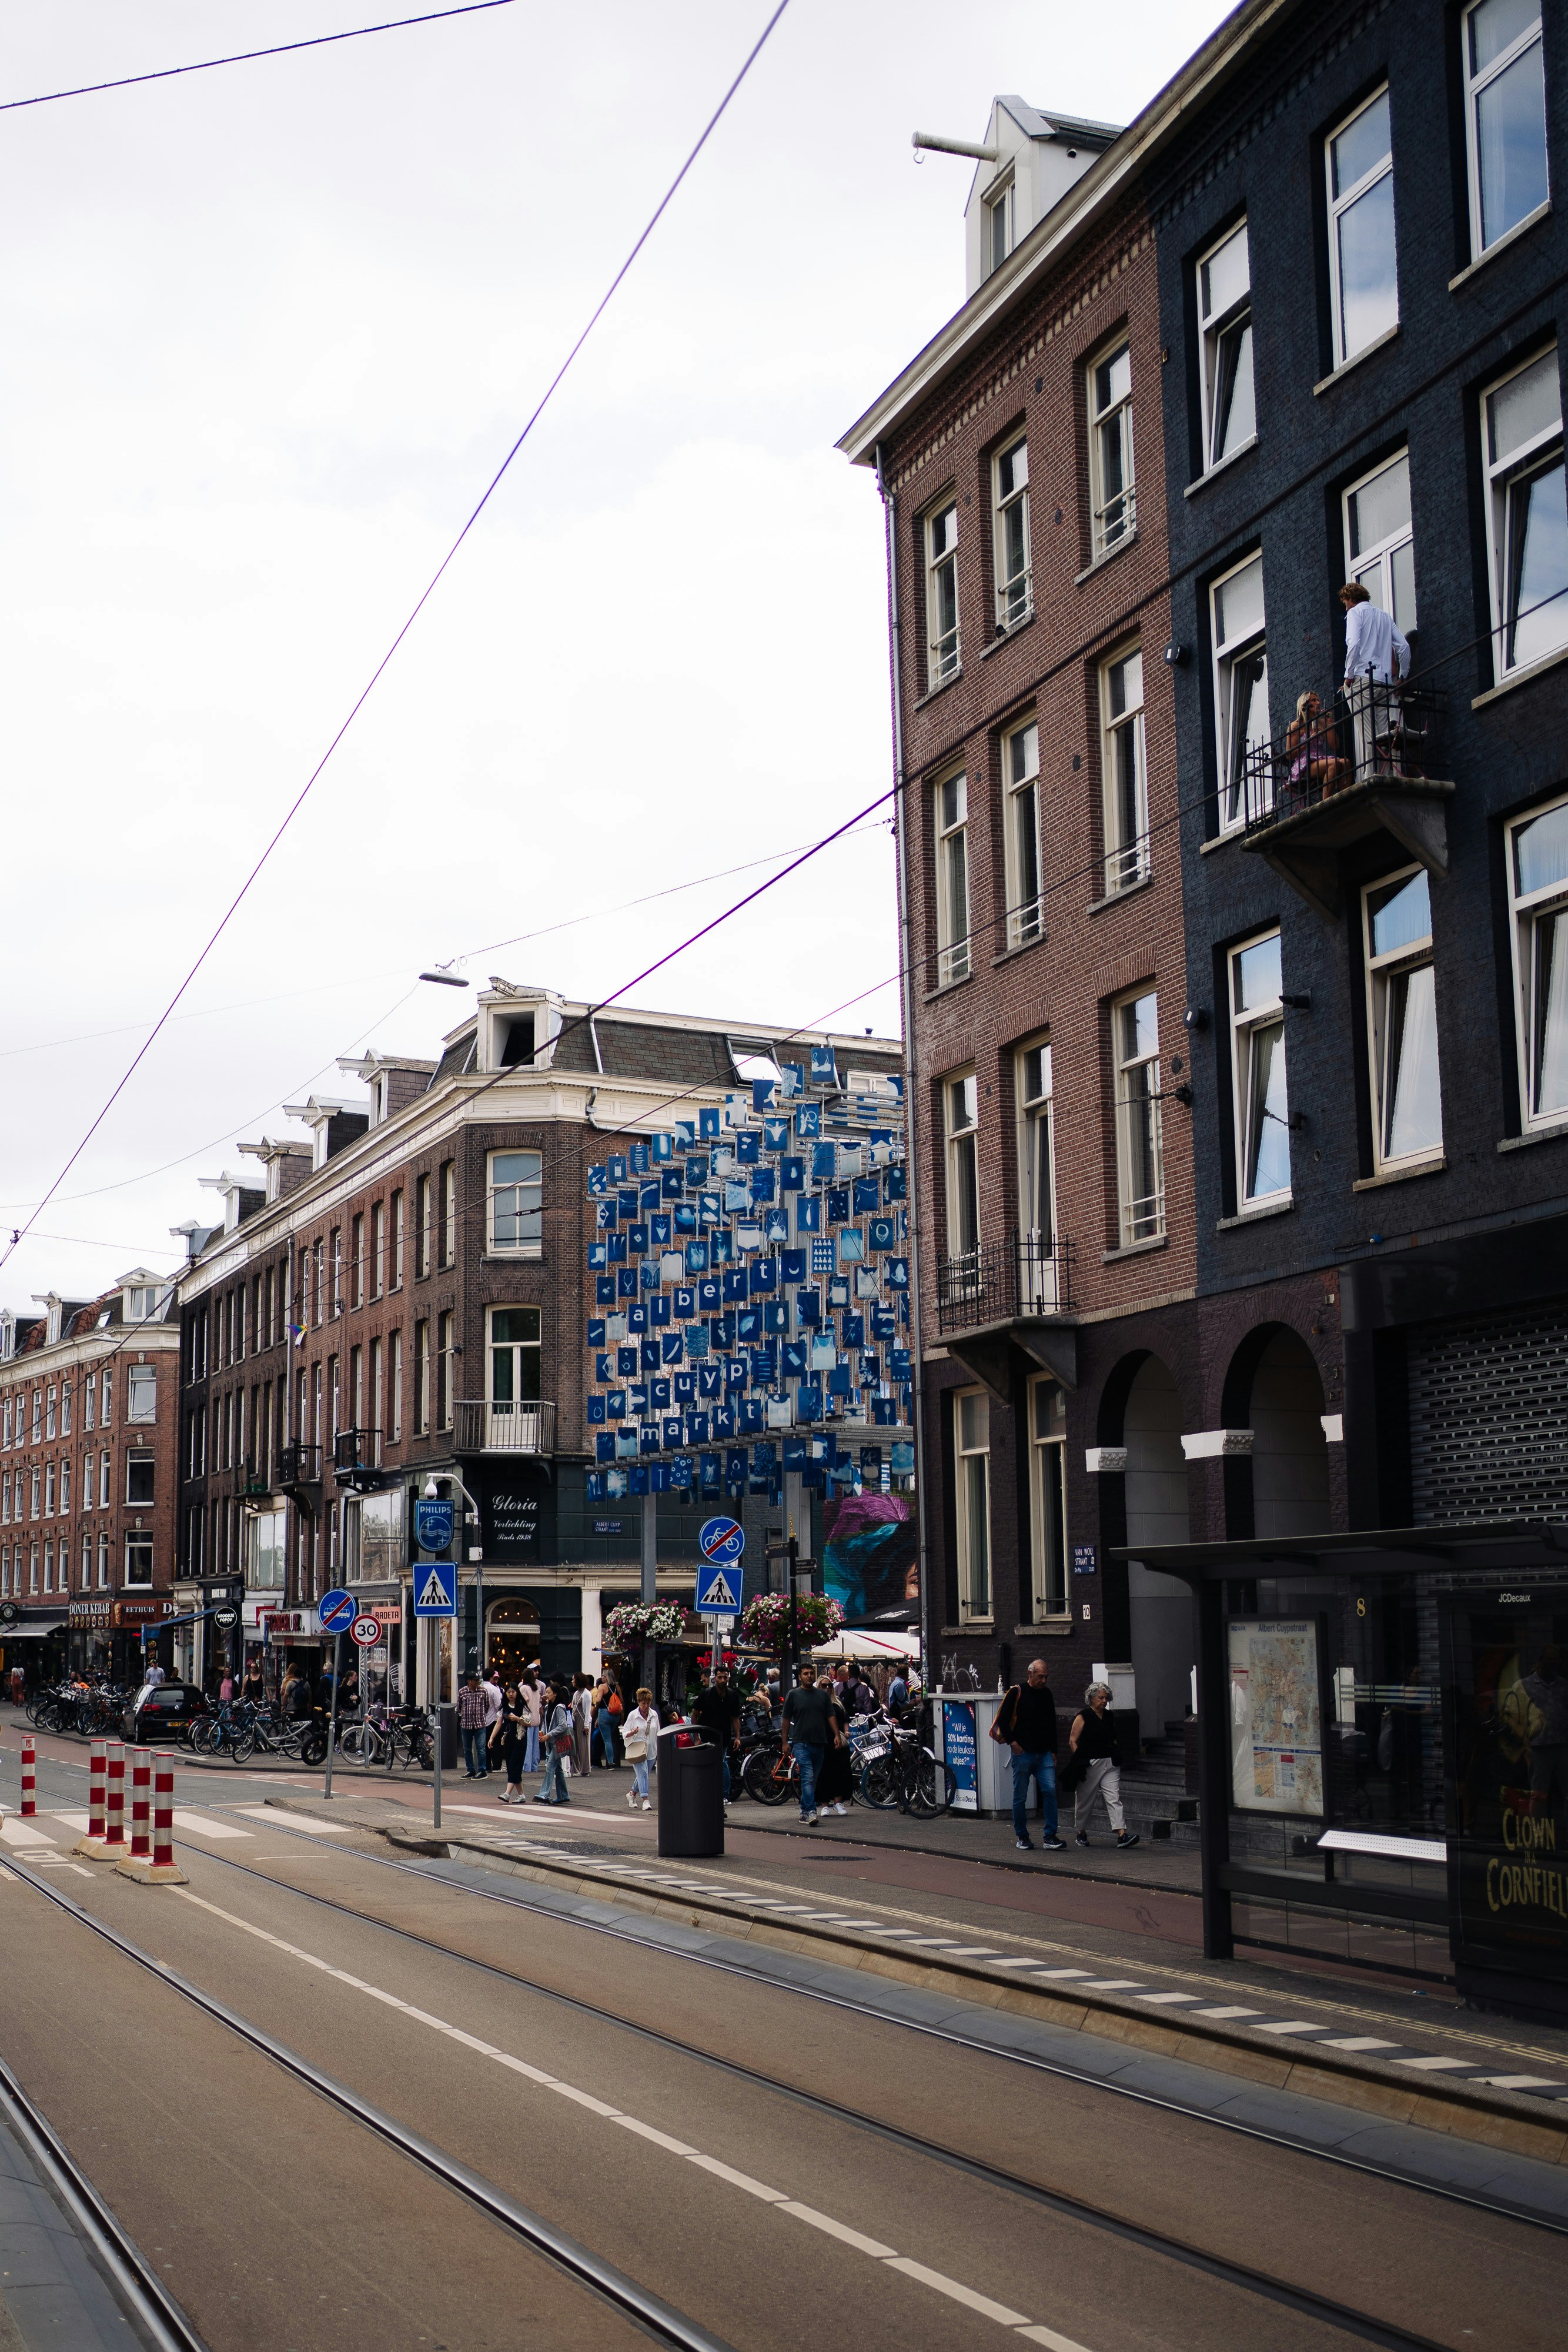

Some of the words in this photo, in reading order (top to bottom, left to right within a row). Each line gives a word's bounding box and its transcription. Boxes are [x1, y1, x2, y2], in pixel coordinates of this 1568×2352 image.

[633, 1262, 768, 1321] albert
[655, 1364, 743, 1396] cuyp
[641, 1403, 754, 1440] markt
[493, 1495, 537, 1510] Gloria
[420, 1506, 452, 1514] PHILIPS
[493, 1519, 536, 1531] Verlichting
[1075, 1557, 1088, 1565] STRAAT
[1499, 1593, 1531, 1602] JCDecaux
[69, 1602, 89, 1615] DÖNER
[90, 1603, 109, 1614] KEBAB
[1084, 1606, 1089, 1617] 10
[1357, 1598, 1366, 1616] 8
[375, 1611, 399, 1619] BADETA
[357, 1624, 377, 1636] 30
[1258, 1623, 1275, 1632] Albert
[1276, 1623, 1307, 1634] Cuypstraat
[961, 1723, 966, 1733] je
[948, 1733, 956, 1742] 50%
[957, 1734, 974, 1745] korting
[952, 1745, 957, 1753] de
[958, 1745, 975, 1755] leukste
[1503, 1808, 1556, 1852] CLOWN
[1524, 1850, 1530, 1864] IN
[1532, 1852, 1536, 1865] A
[1486, 1858, 1568, 1919] CORNFIEL
